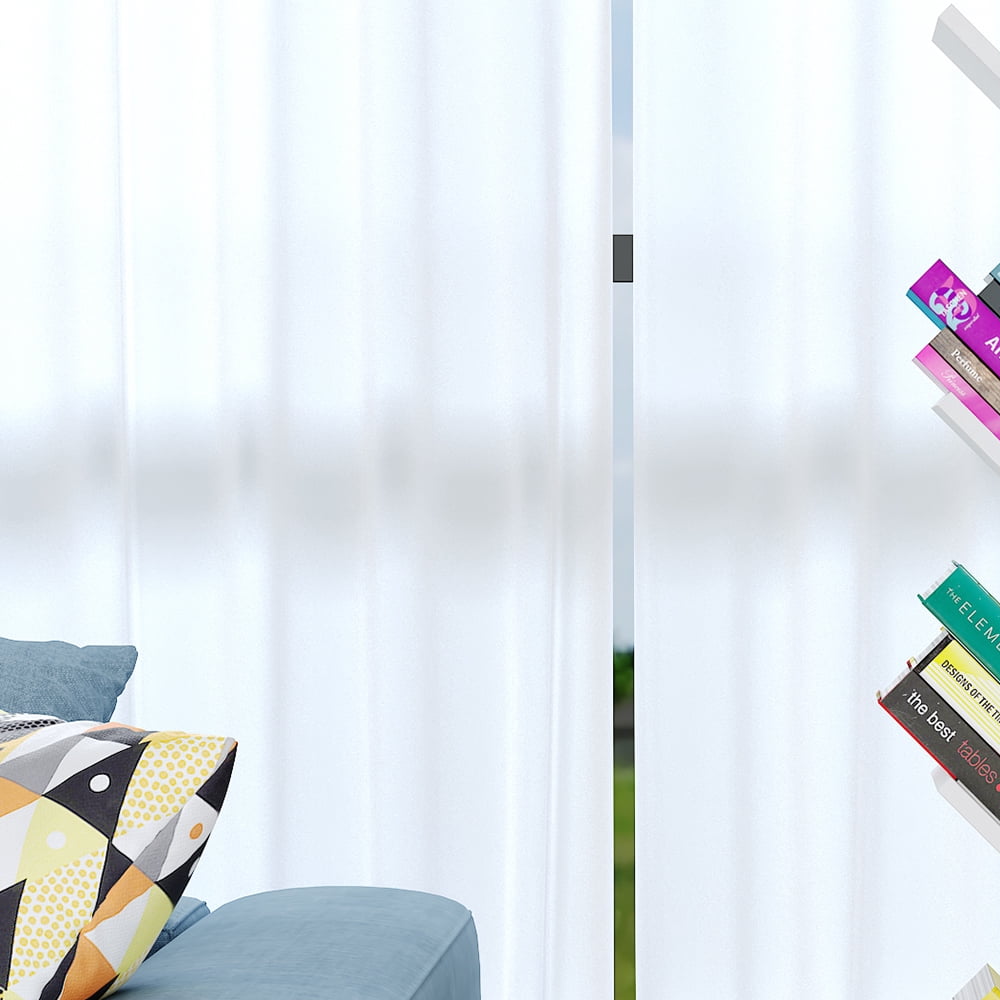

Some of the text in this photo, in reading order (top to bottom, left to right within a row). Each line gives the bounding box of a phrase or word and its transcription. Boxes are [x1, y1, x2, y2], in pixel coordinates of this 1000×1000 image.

[950, 348, 985, 383] Perfume
[944, 586, 963, 604] THE
[940, 659, 973, 691] DESIGNS
[968, 687, 983, 701] OF
[978, 696, 995, 714] THE
[905, 690, 931, 716] the
[925, 711, 958, 743] best
[954, 739, 1000, 785] tables
